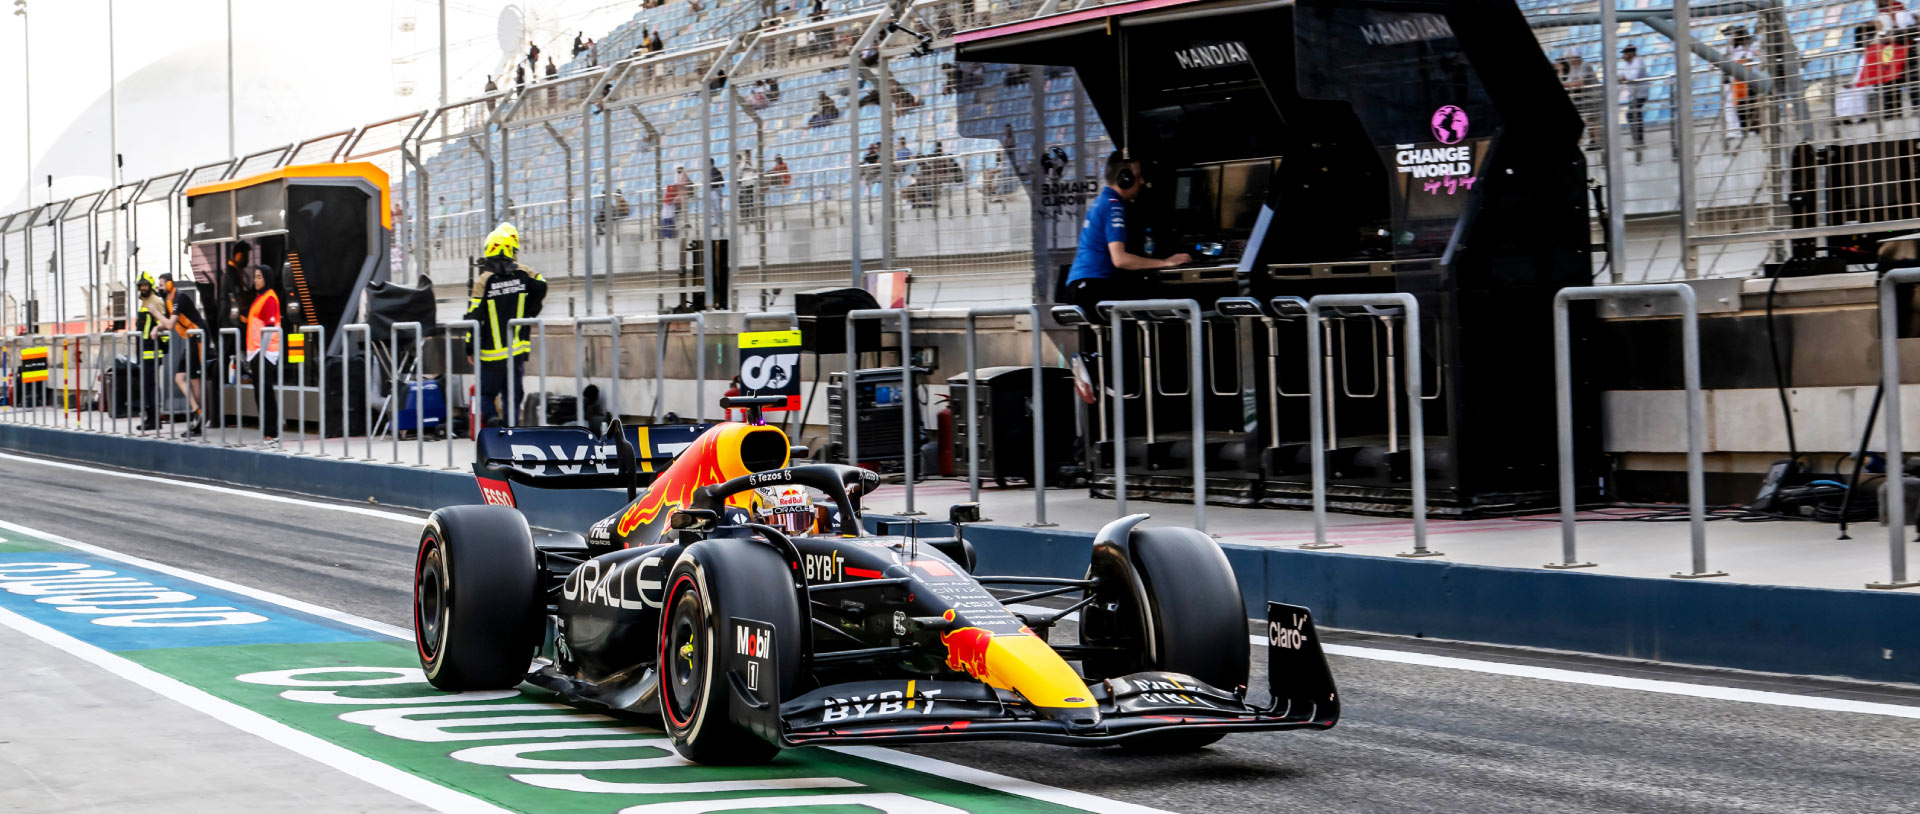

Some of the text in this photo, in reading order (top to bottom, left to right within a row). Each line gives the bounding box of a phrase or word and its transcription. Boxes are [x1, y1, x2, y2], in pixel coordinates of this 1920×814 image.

[1396, 146, 1471, 165] CHANGE
[1412, 161, 1472, 178] WORLD
[757, 471, 783, 482] Tezos
[483, 487, 513, 507] ESSO
[779, 496, 804, 506] Red Bull
[774, 505, 810, 515] ORACLE
[806, 549, 845, 583] BYBIT
[563, 556, 664, 610] ORACLE
[736, 625, 771, 660] Mobil
[1269, 620, 1303, 650] Claro
[749, 662, 757, 689] 1
[822, 679, 942, 723] BYBIT
